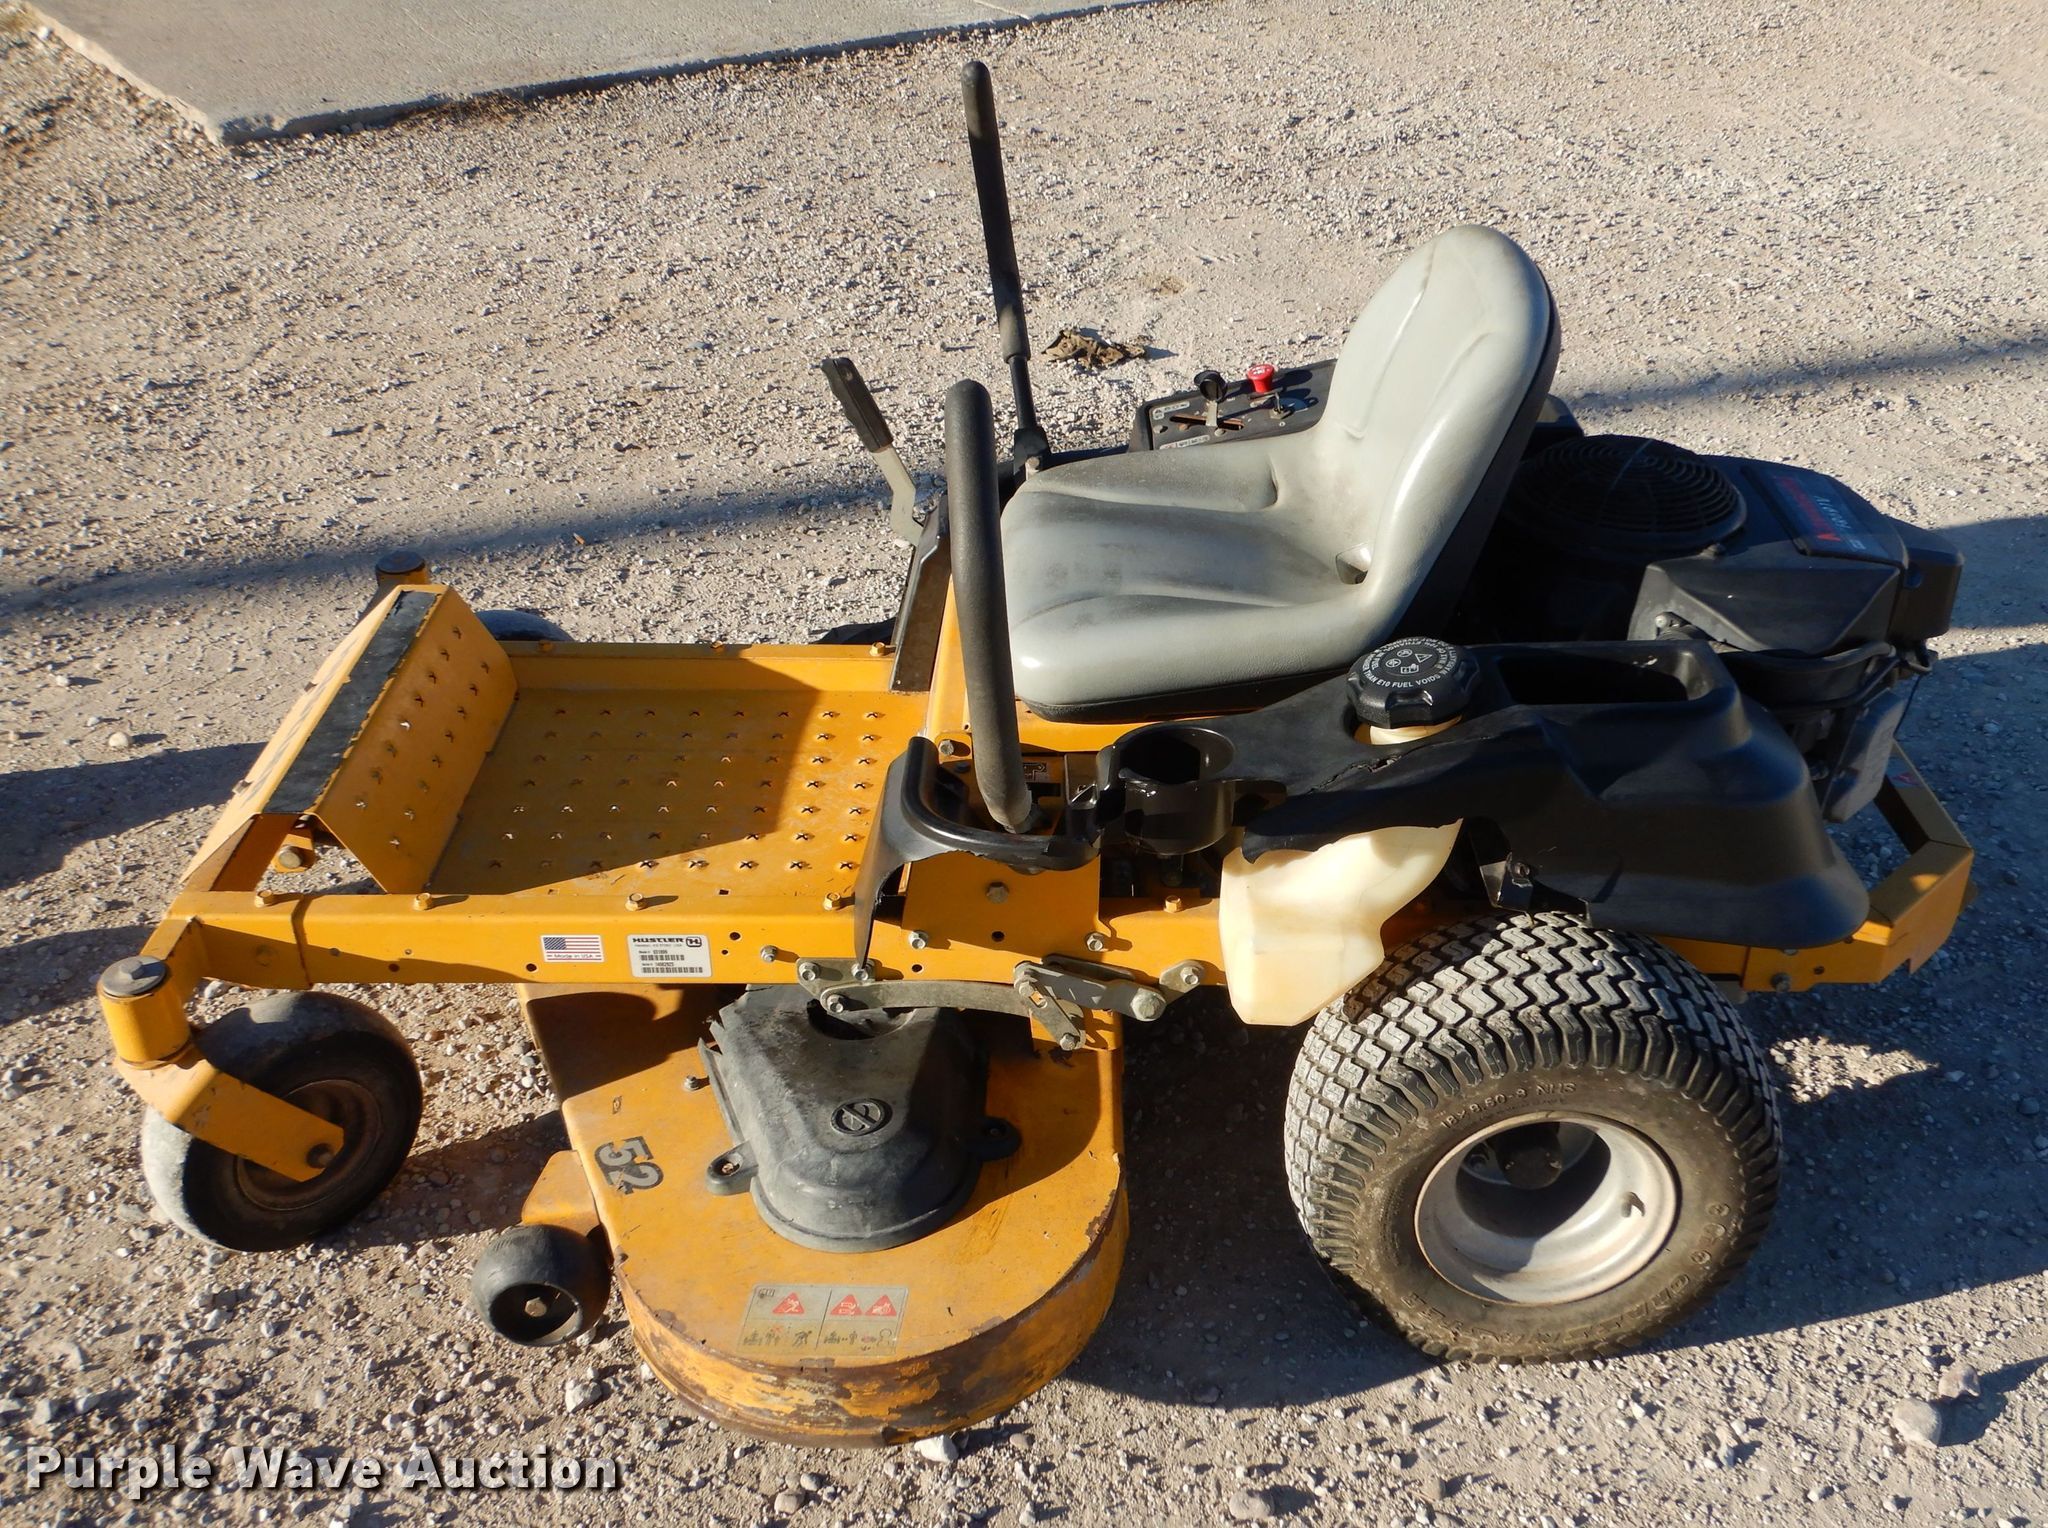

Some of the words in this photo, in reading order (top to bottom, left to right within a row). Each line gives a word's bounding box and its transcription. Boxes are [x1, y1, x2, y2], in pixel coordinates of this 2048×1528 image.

[1377, 679, 1391, 688] E10
[1416, 673, 1441, 686] VOIDS
[594, 1135, 664, 1194] 52
